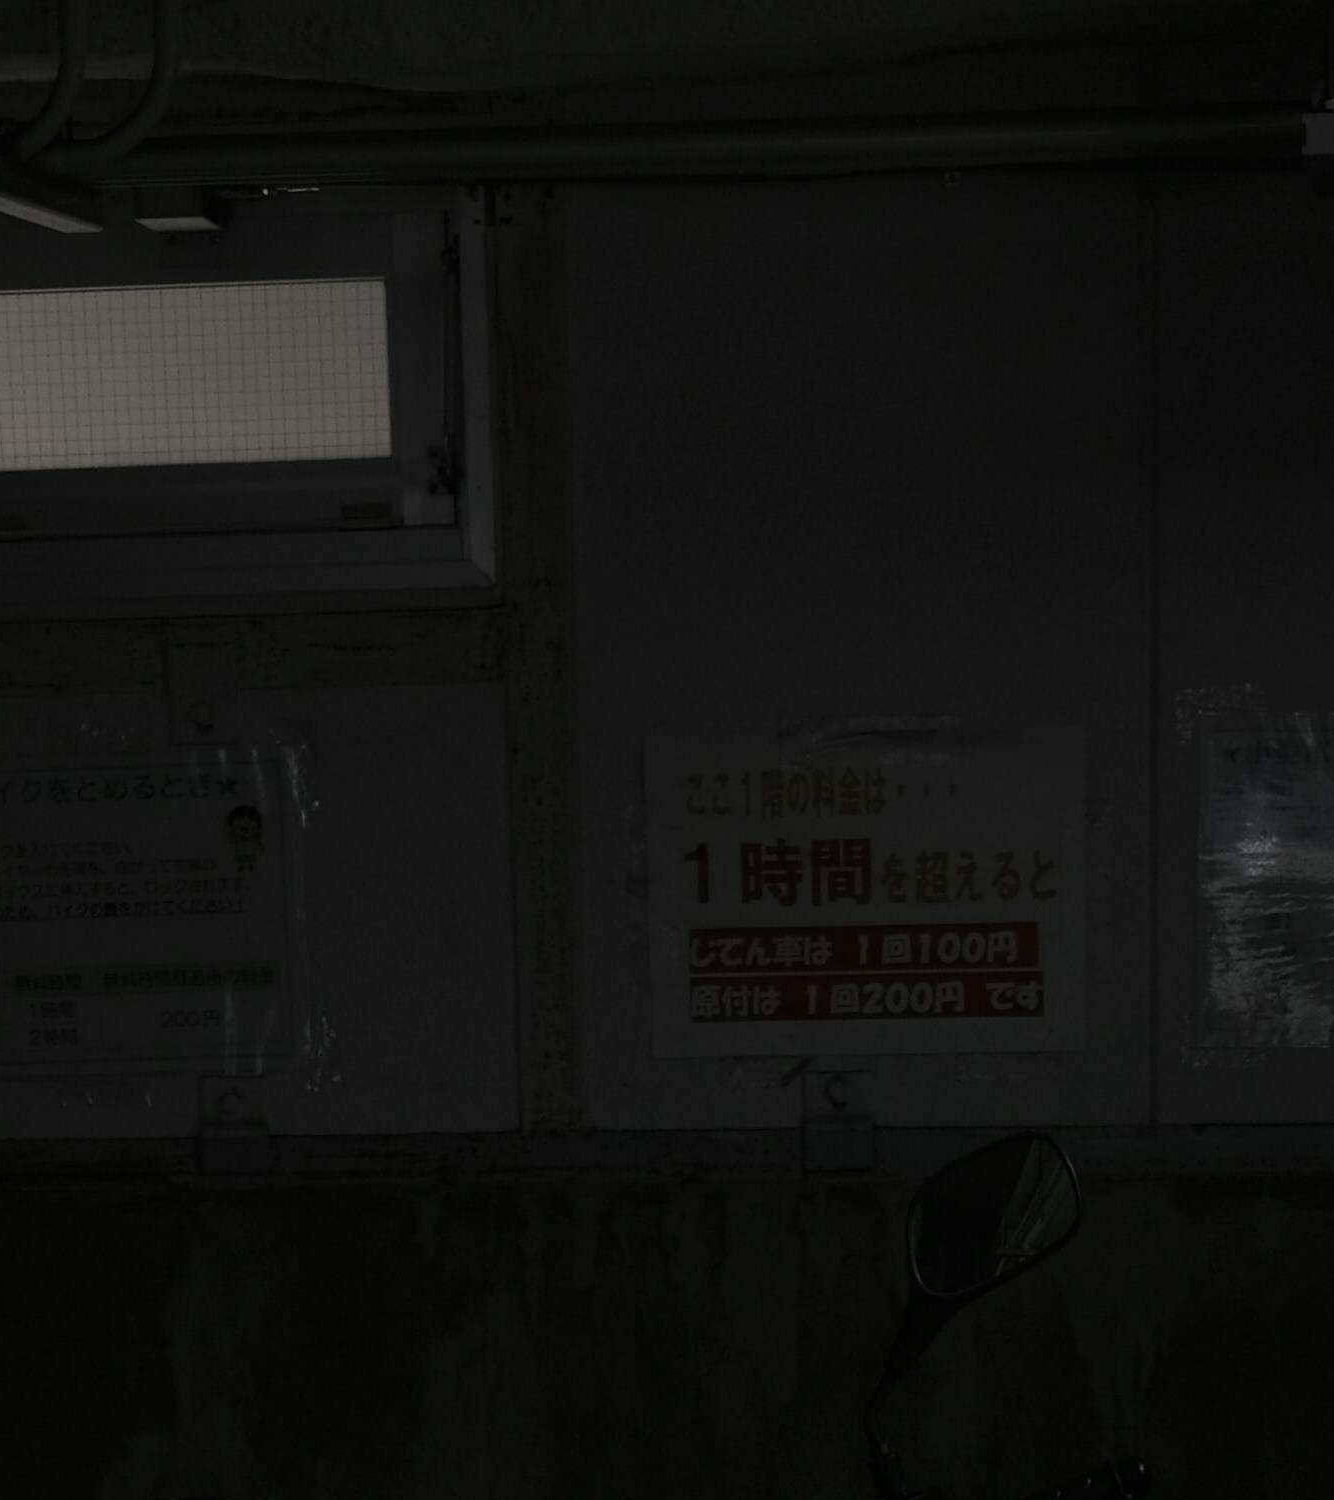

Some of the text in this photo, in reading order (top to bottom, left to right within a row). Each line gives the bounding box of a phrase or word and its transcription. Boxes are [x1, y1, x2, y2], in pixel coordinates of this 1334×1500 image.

[690, 938, 831, 967] じてん車は
[691, 985, 780, 1017] 原付は
[987, 981, 1044, 1011] です
